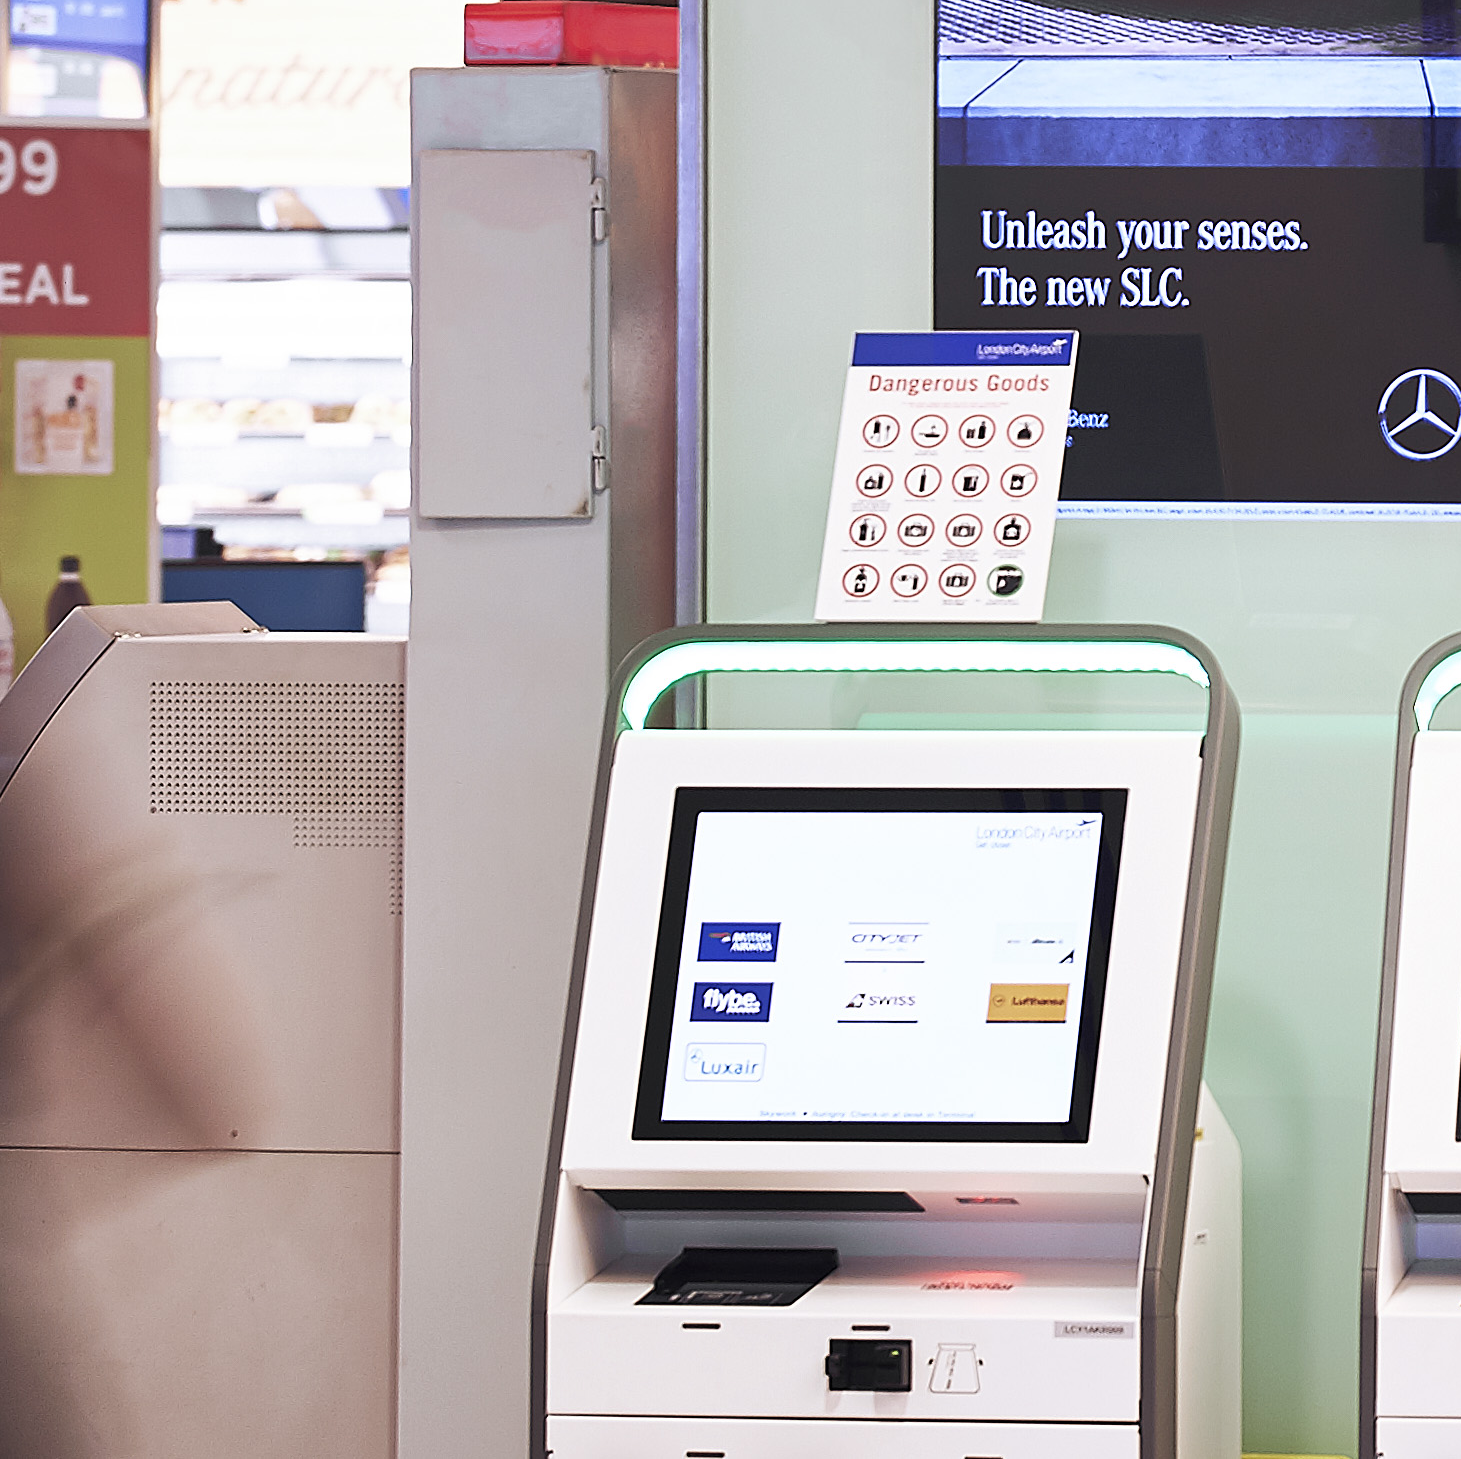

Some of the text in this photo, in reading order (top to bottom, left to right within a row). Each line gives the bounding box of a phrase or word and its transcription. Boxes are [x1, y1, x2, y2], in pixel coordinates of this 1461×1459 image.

[980, 210, 1309, 260] Unleash your senses.
[976, 267, 1190, 307] The new SLC.
[869, 374, 1050, 396] Dangerous Goods
[976, 826, 1091, 842] London City Airport
[869, 995, 916, 1006] SWISS
[701, 1060, 760, 1075] Luxair
